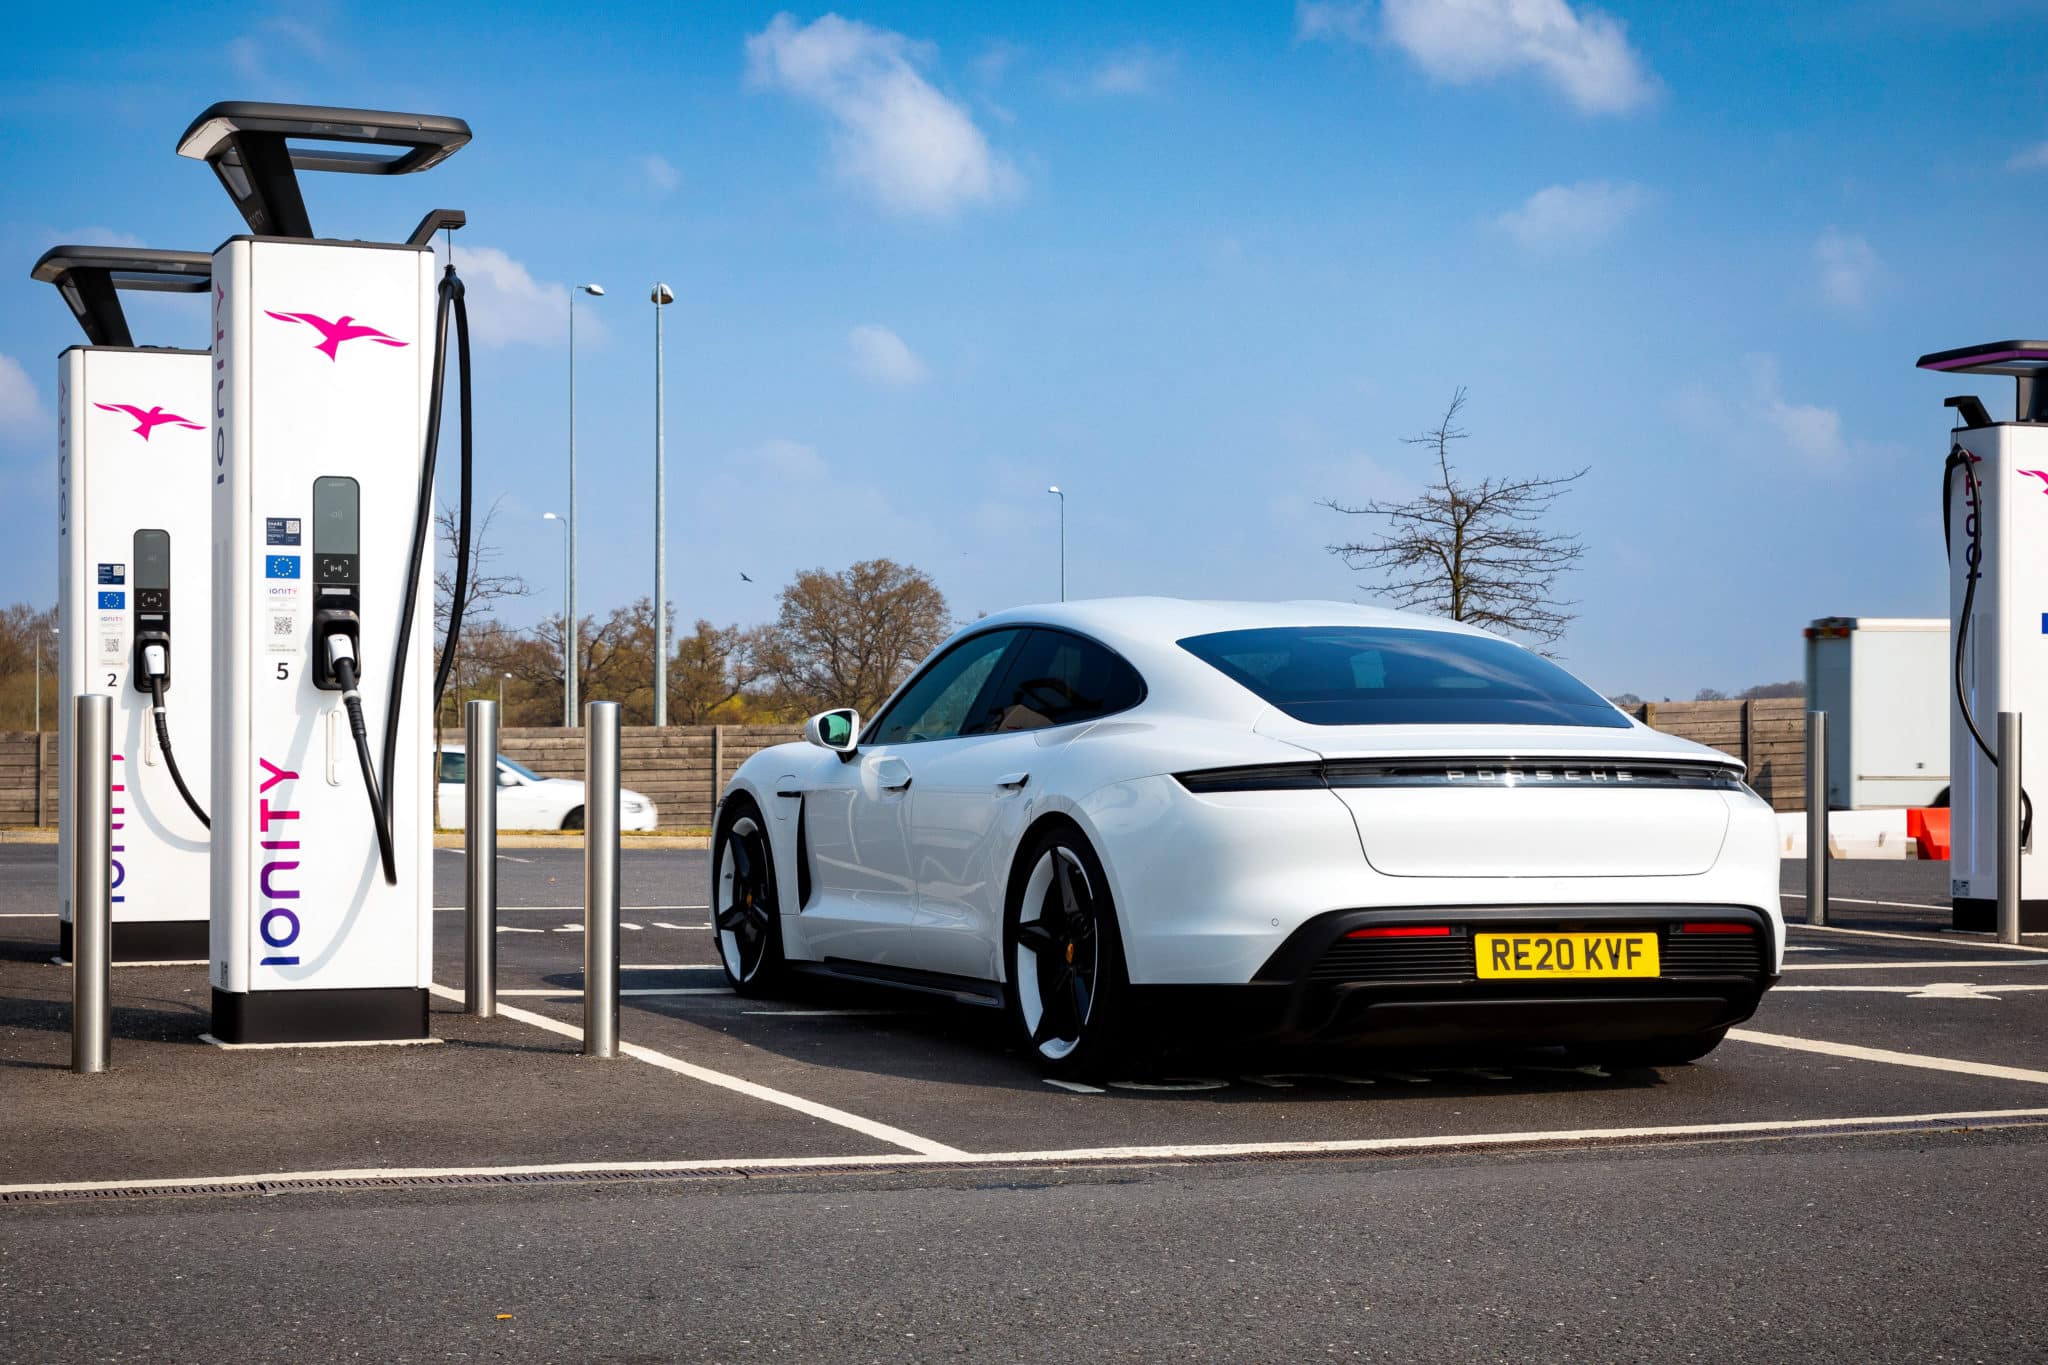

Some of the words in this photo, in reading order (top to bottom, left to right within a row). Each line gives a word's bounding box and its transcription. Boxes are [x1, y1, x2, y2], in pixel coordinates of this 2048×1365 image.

[107, 673, 118, 687] 2
[276, 662, 289, 681] 5
[1447, 770, 1633, 782] PORSCHE
[260, 757, 300, 966] IONITY
[1491, 938, 1574, 971] RE20
[1584, 938, 1643, 971] KVF
